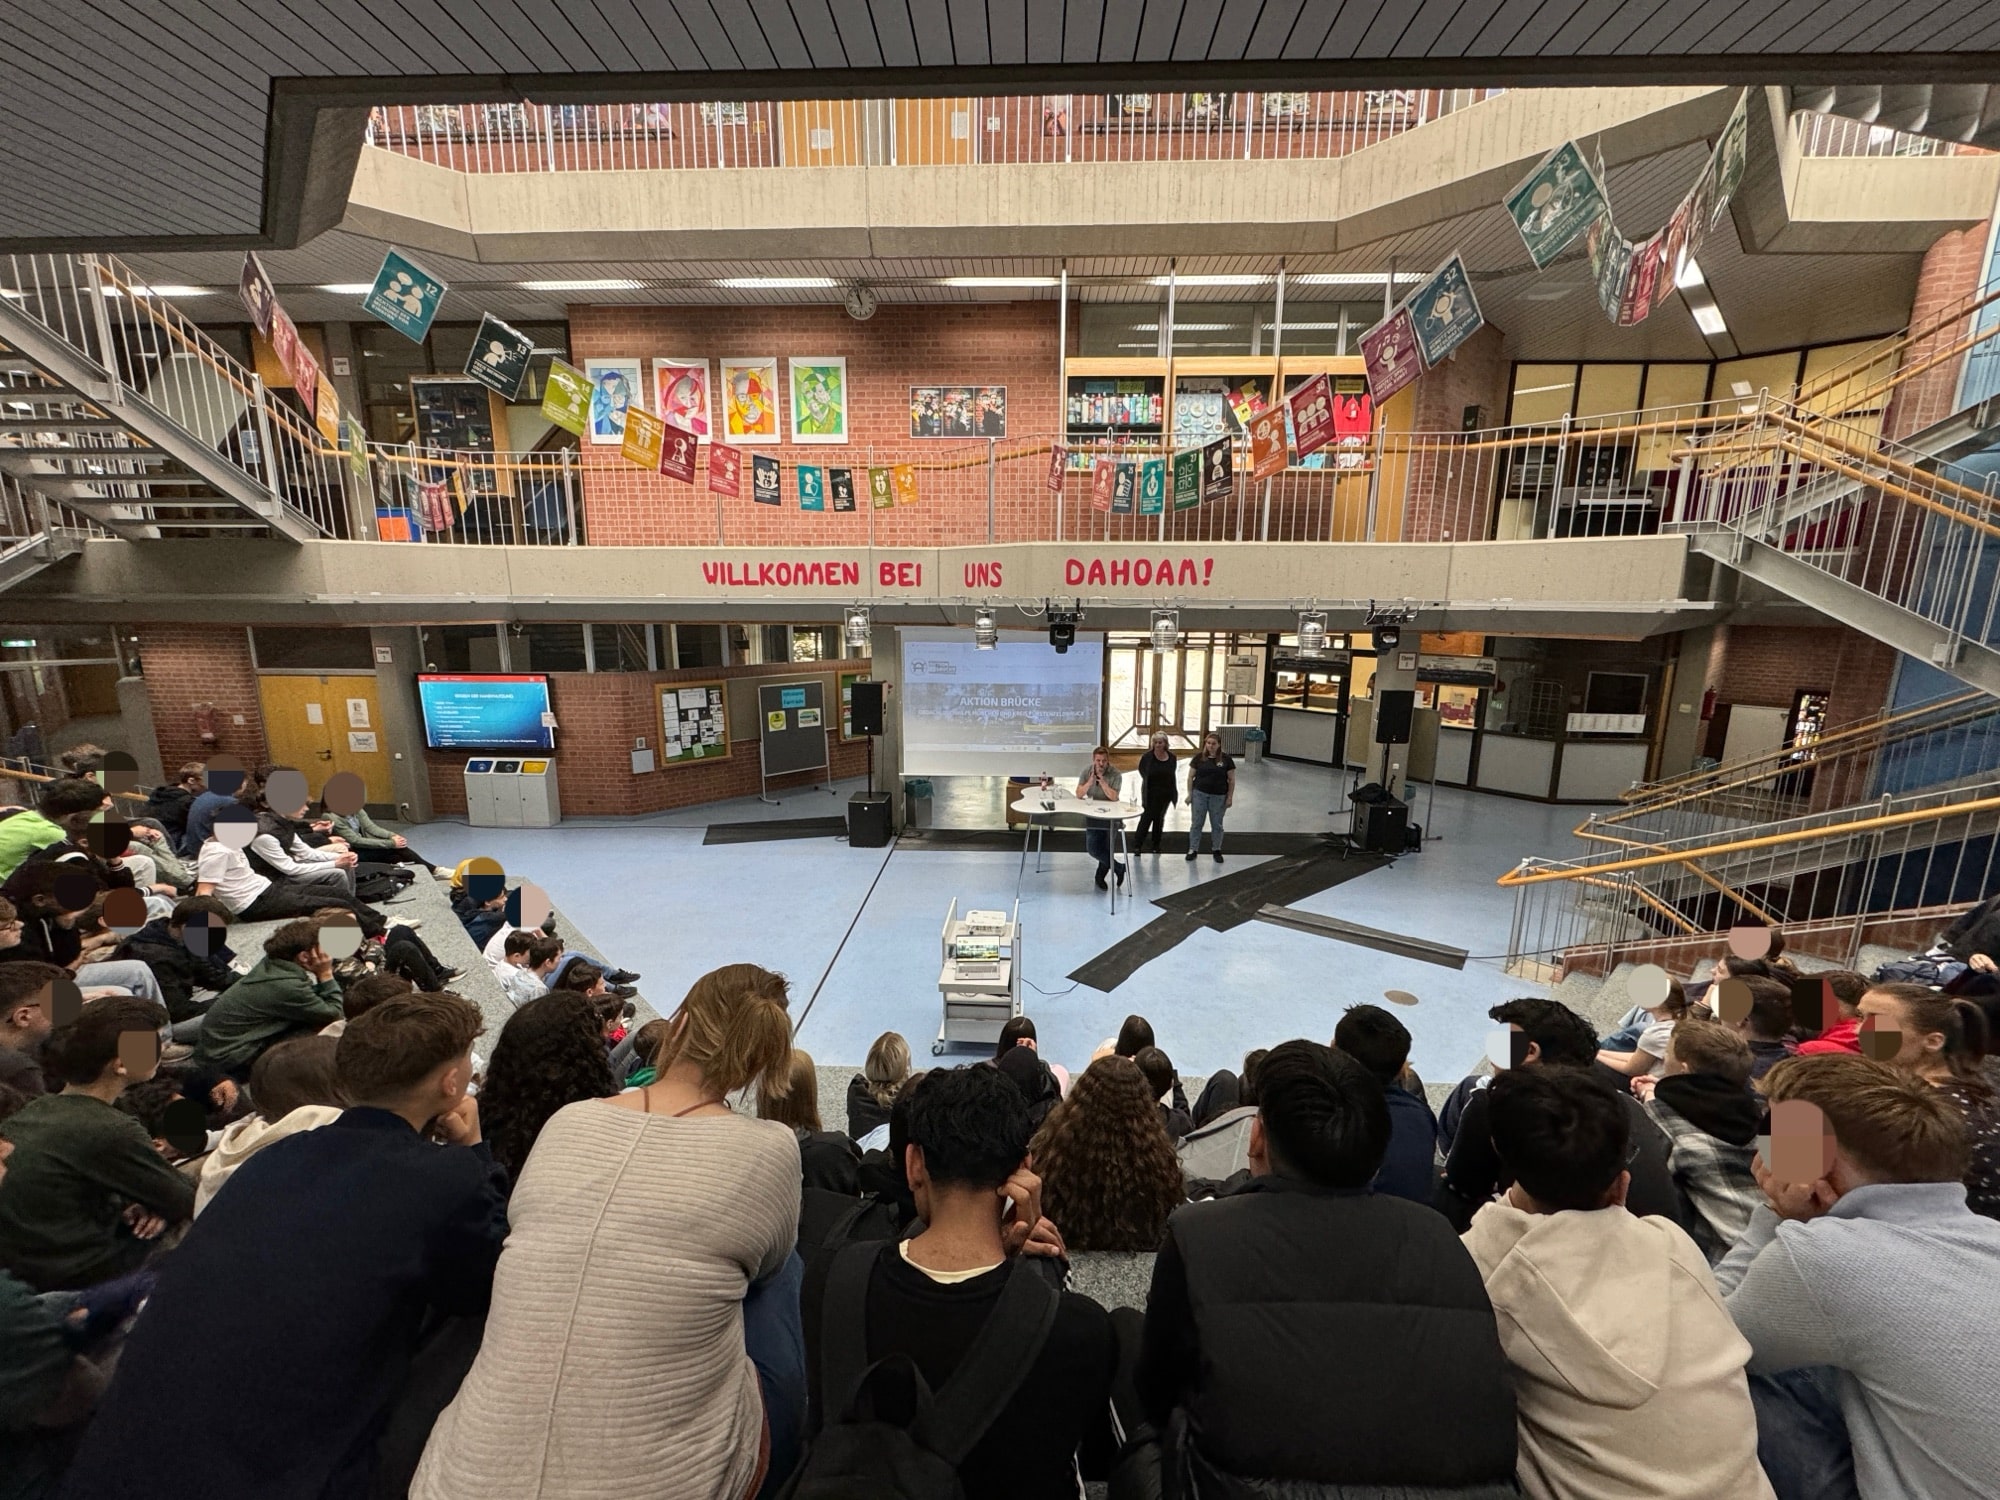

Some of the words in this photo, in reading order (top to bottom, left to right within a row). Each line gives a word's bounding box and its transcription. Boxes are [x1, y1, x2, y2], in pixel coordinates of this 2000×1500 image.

[1444, 267, 1458, 285] 32
[425, 282, 438, 296] 12
[1394, 314, 1406, 330] 31
[516, 343, 527, 356] 13
[582, 384, 590, 394] 14
[1316, 380, 1325, 394] 30
[732, 452, 738, 460] 17
[702, 561, 860, 586] WILLKOMMEN
[879, 562, 922, 587] BEI
[964, 562, 1003, 588] UNS
[1065, 558, 1214, 587] DAHOAM!
[960, 697, 998, 706] AKTION
[1000, 696, 1041, 707] BRÜCKE
